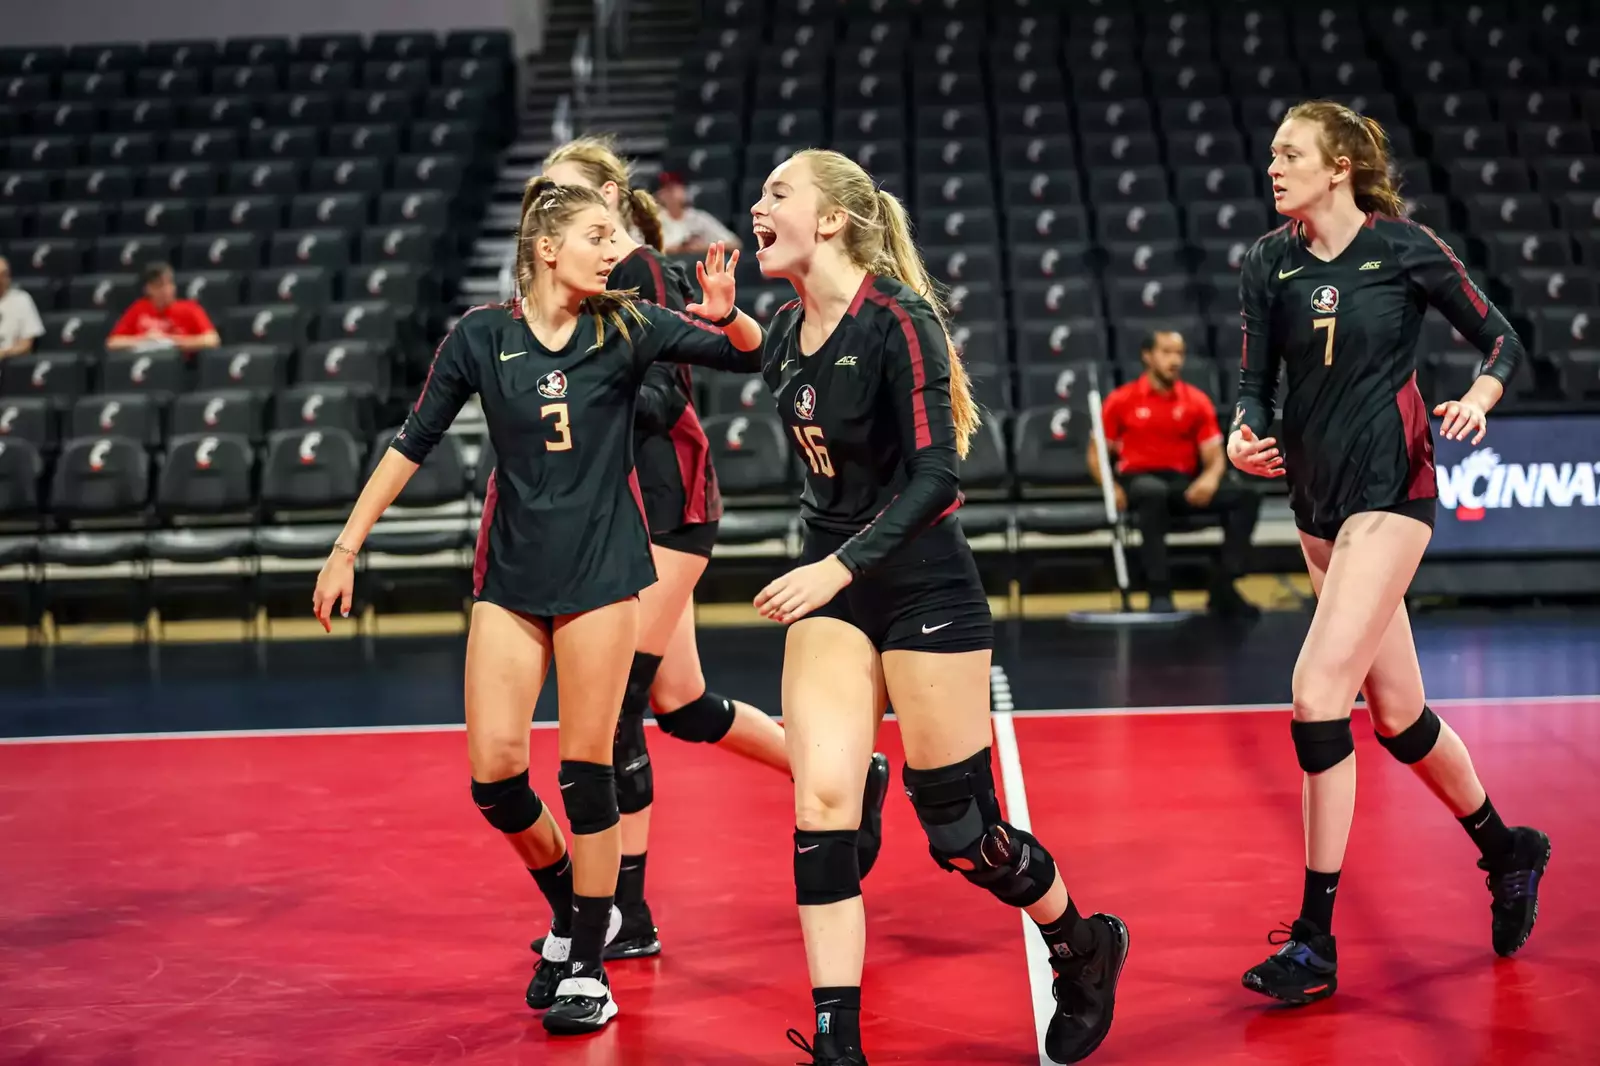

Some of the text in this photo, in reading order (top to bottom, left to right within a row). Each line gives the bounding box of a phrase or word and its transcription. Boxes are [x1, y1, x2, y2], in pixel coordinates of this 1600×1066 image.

[1359, 260, 1381, 271] ACC
[834, 355, 858, 366] ACC
[1312, 317, 1336, 366] 7
[540, 402, 573, 452] 3
[791, 425, 836, 478] 16
[1436, 447, 1600, 510] NCINNA
